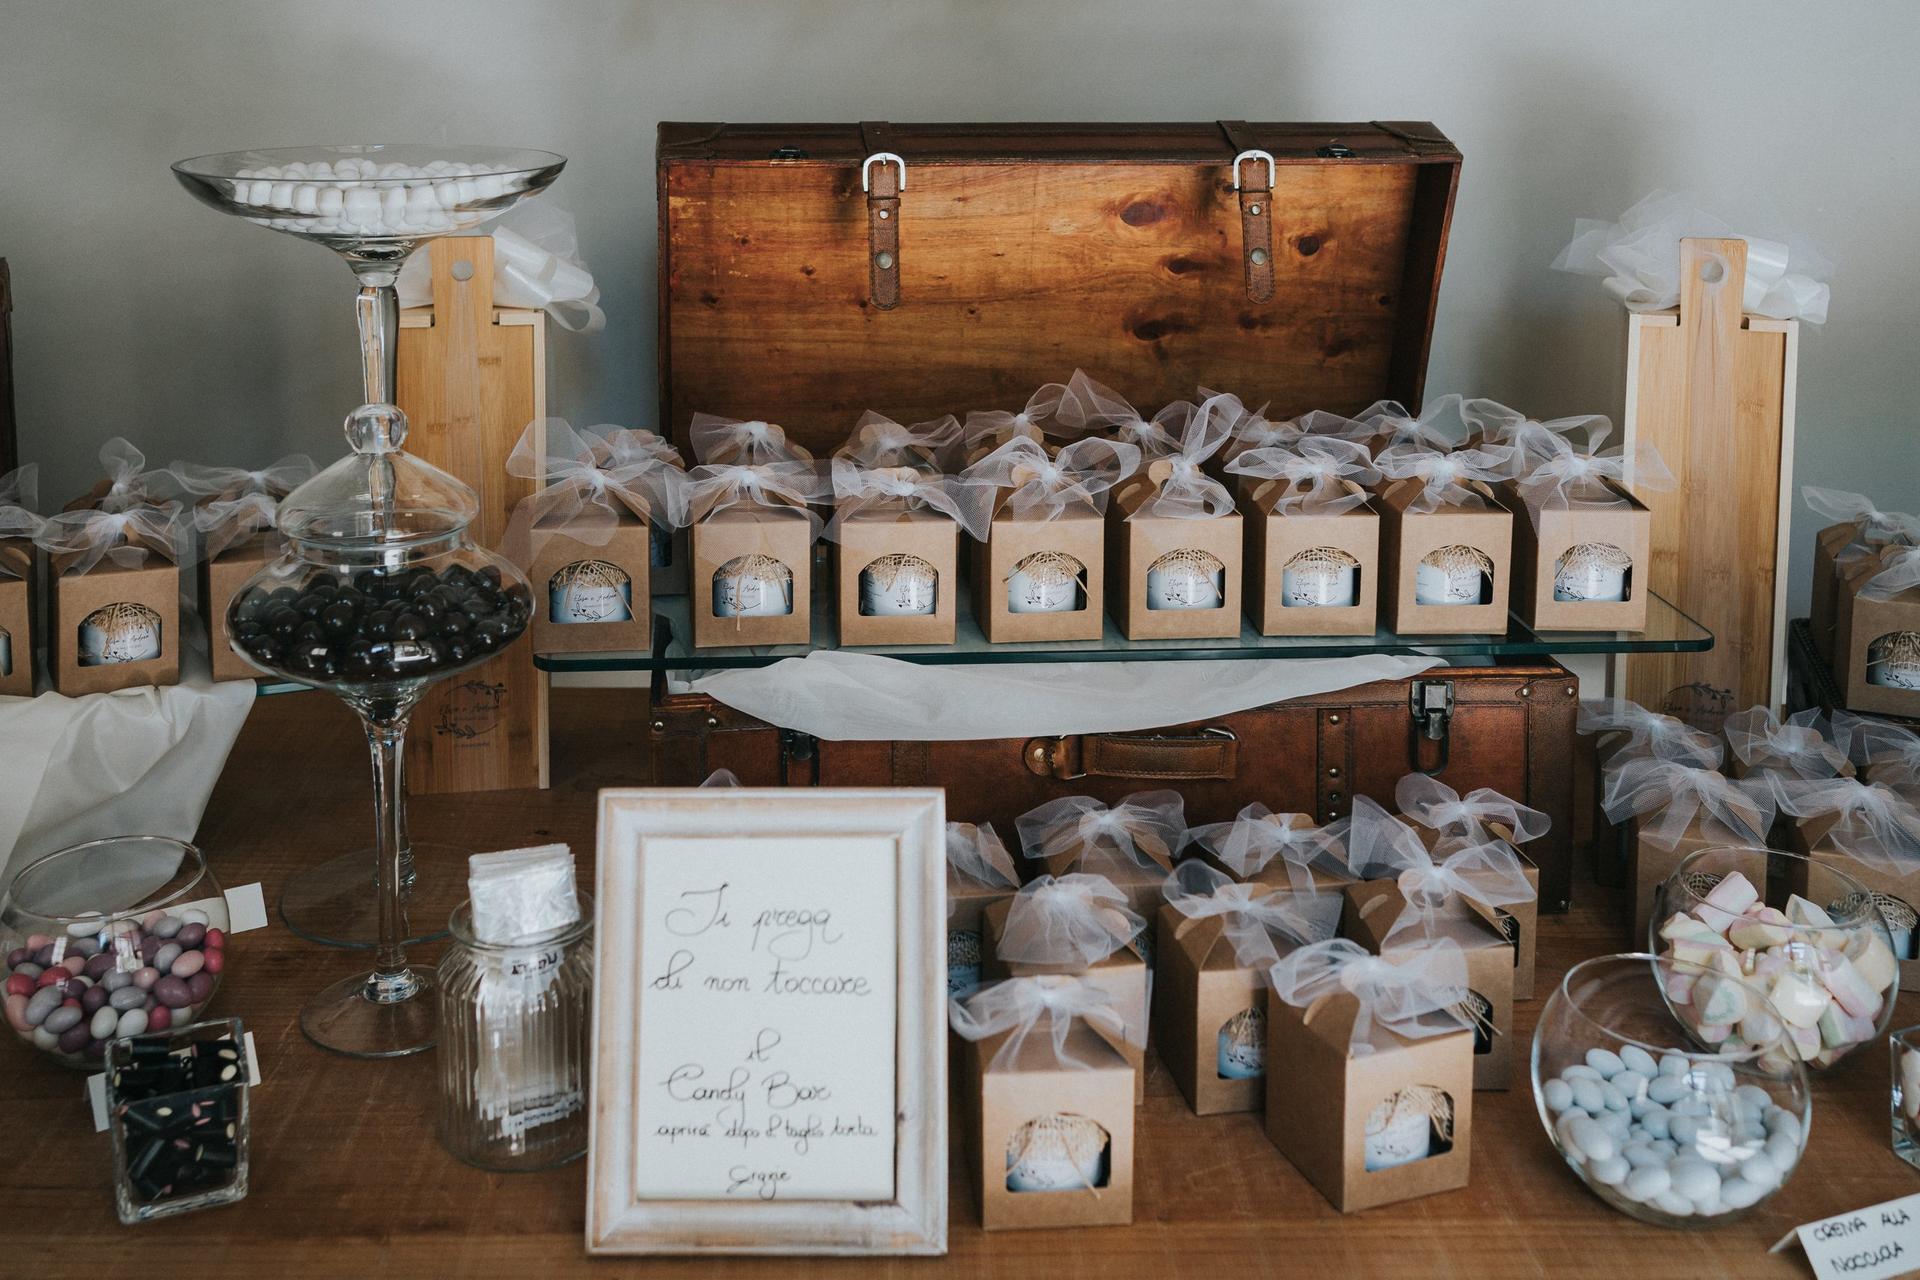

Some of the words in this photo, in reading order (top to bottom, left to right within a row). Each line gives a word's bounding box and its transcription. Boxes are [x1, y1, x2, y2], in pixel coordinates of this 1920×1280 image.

[649, 949, 695, 992] di
[703, 975, 751, 993] non
[763, 958, 873, 997] toccare
[745, 1027, 781, 1063] il
[657, 1062, 751, 1126] Candy
[760, 1070, 832, 1110] Bar
[1813, 1216, 1868, 1242] CREMA
[1880, 1208, 1911, 1227] ALLA
[1830, 1241, 1904, 1273] NOCCIOLA
